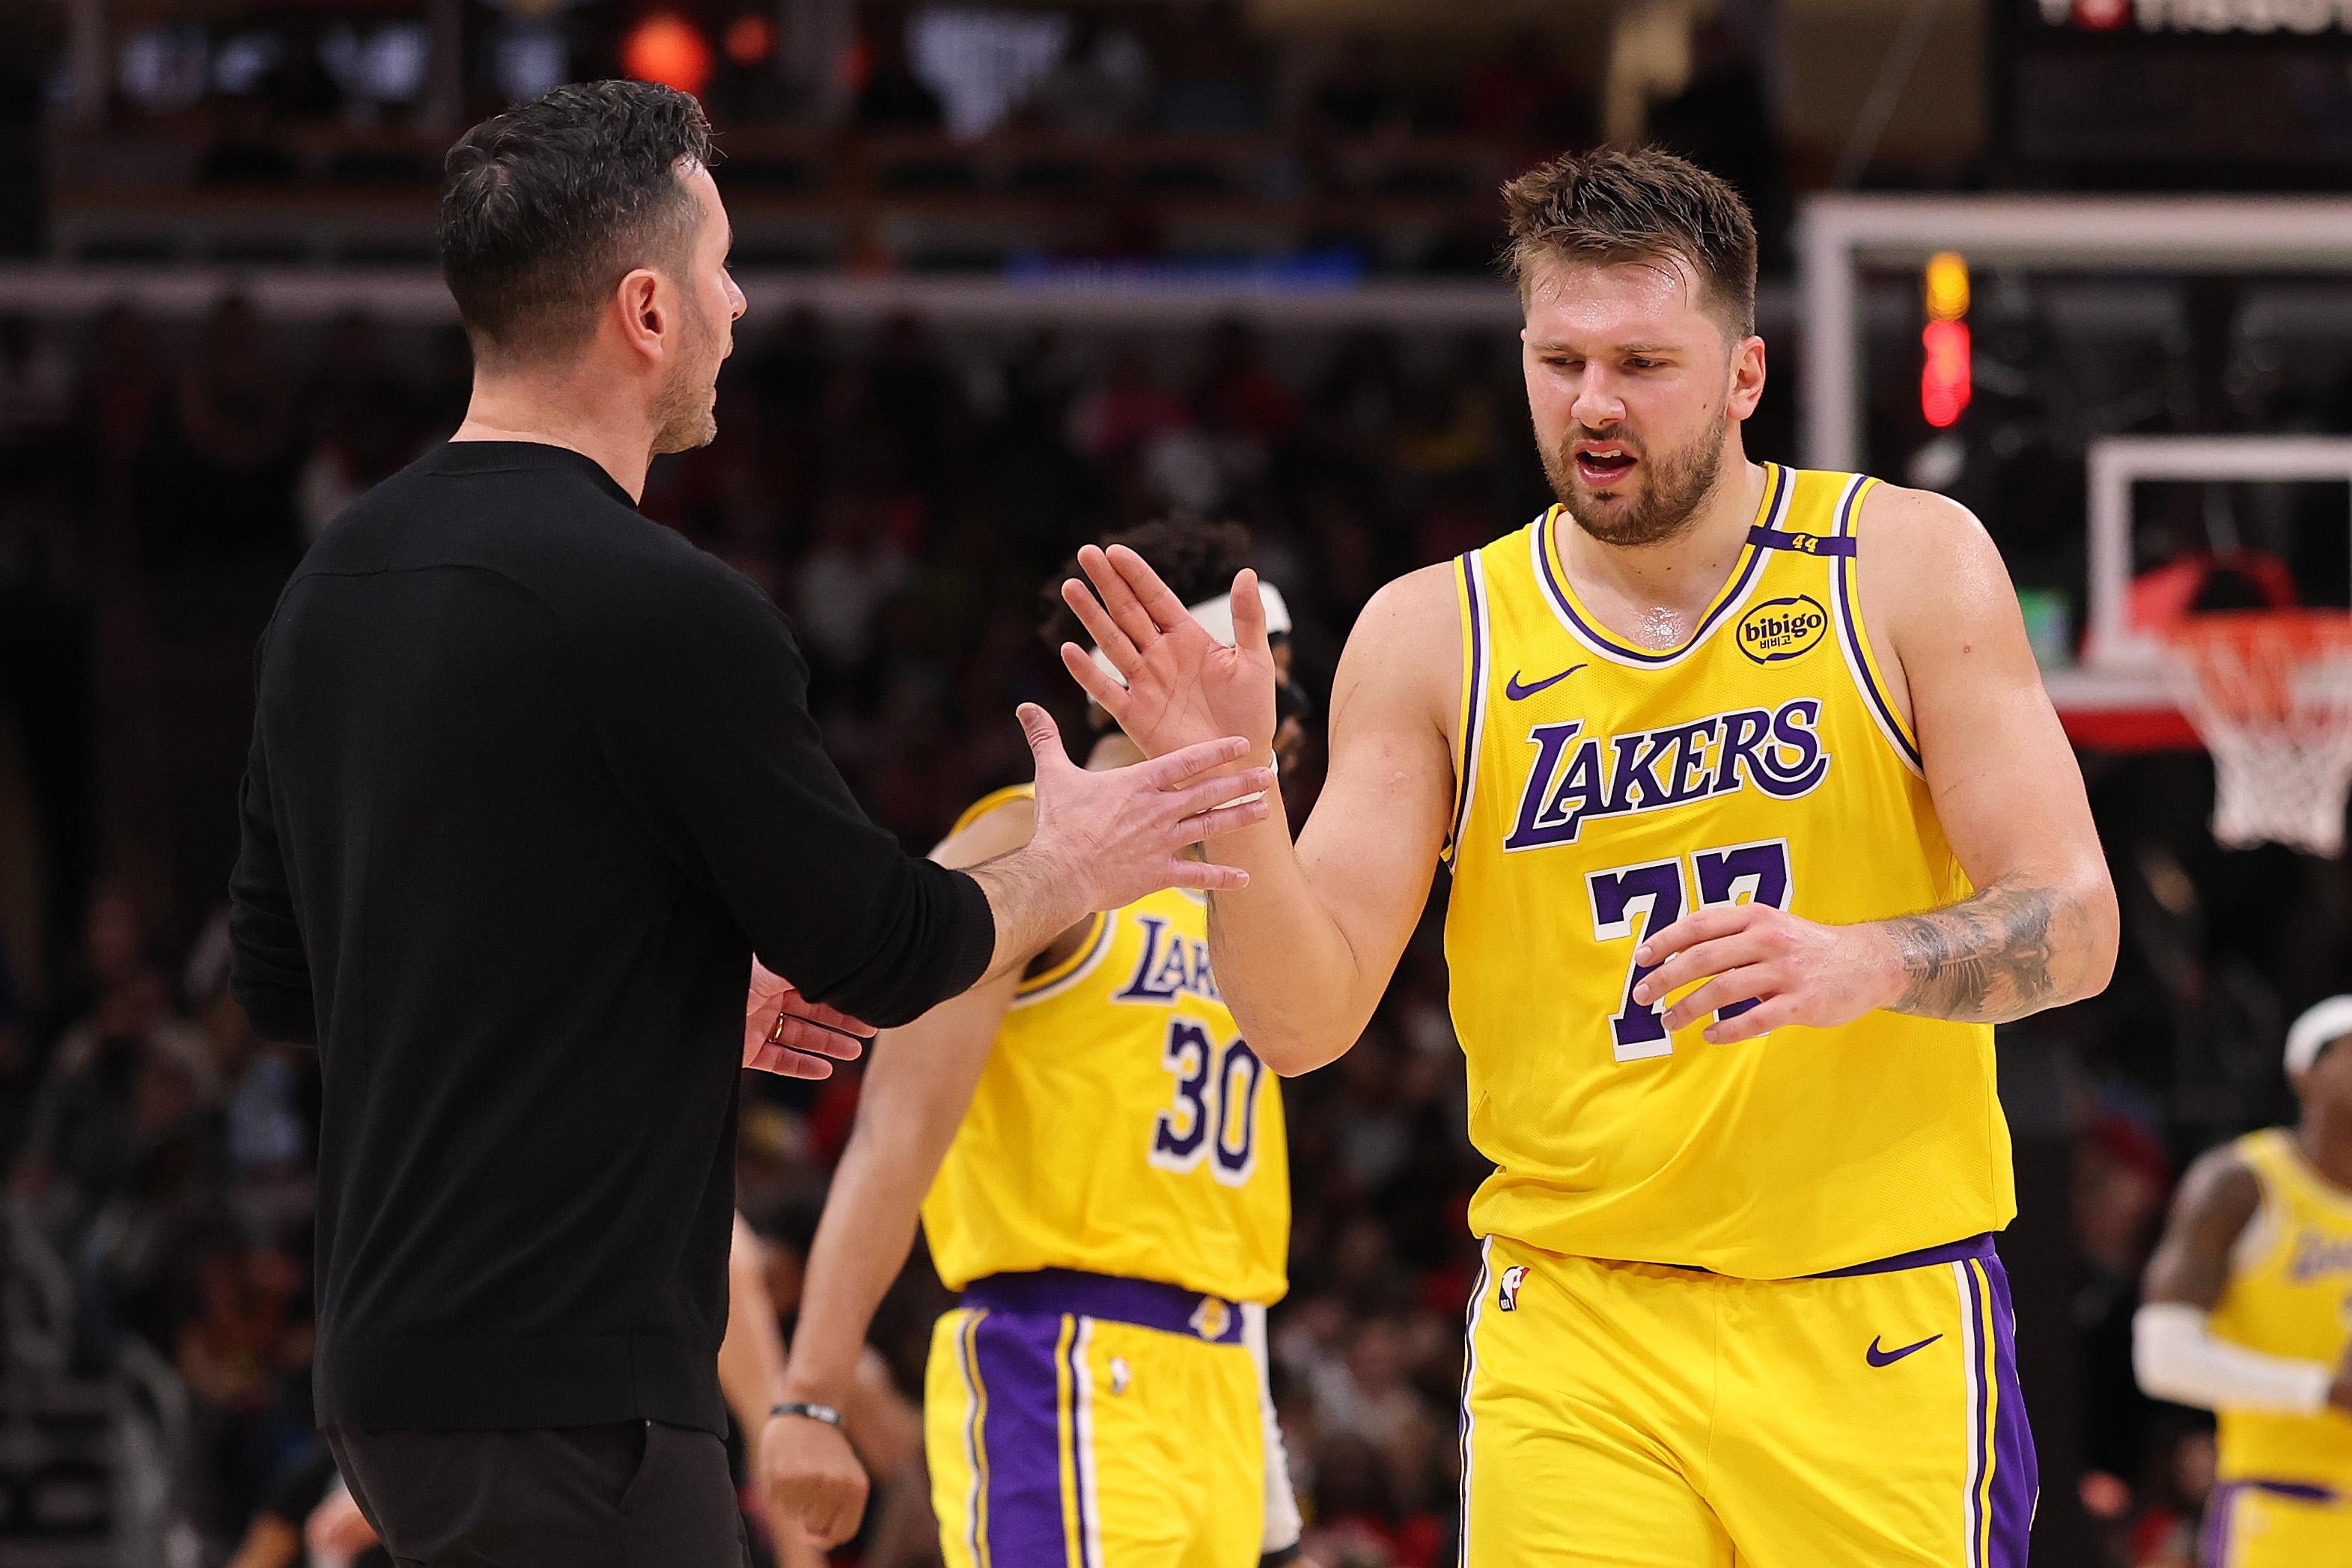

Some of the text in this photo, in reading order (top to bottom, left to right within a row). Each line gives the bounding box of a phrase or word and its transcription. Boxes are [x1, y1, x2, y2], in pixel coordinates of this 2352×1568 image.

[1792, 534, 1819, 553] 44
[1745, 613, 1822, 642] bibigo
[1760, 635, 1792, 650] 비비고
[1503, 697, 1832, 854] LAKERS
[1111, 912, 1225, 1007] LAK
[1584, 838, 1794, 1063] 77
[1149, 1016, 1265, 1189] 30
